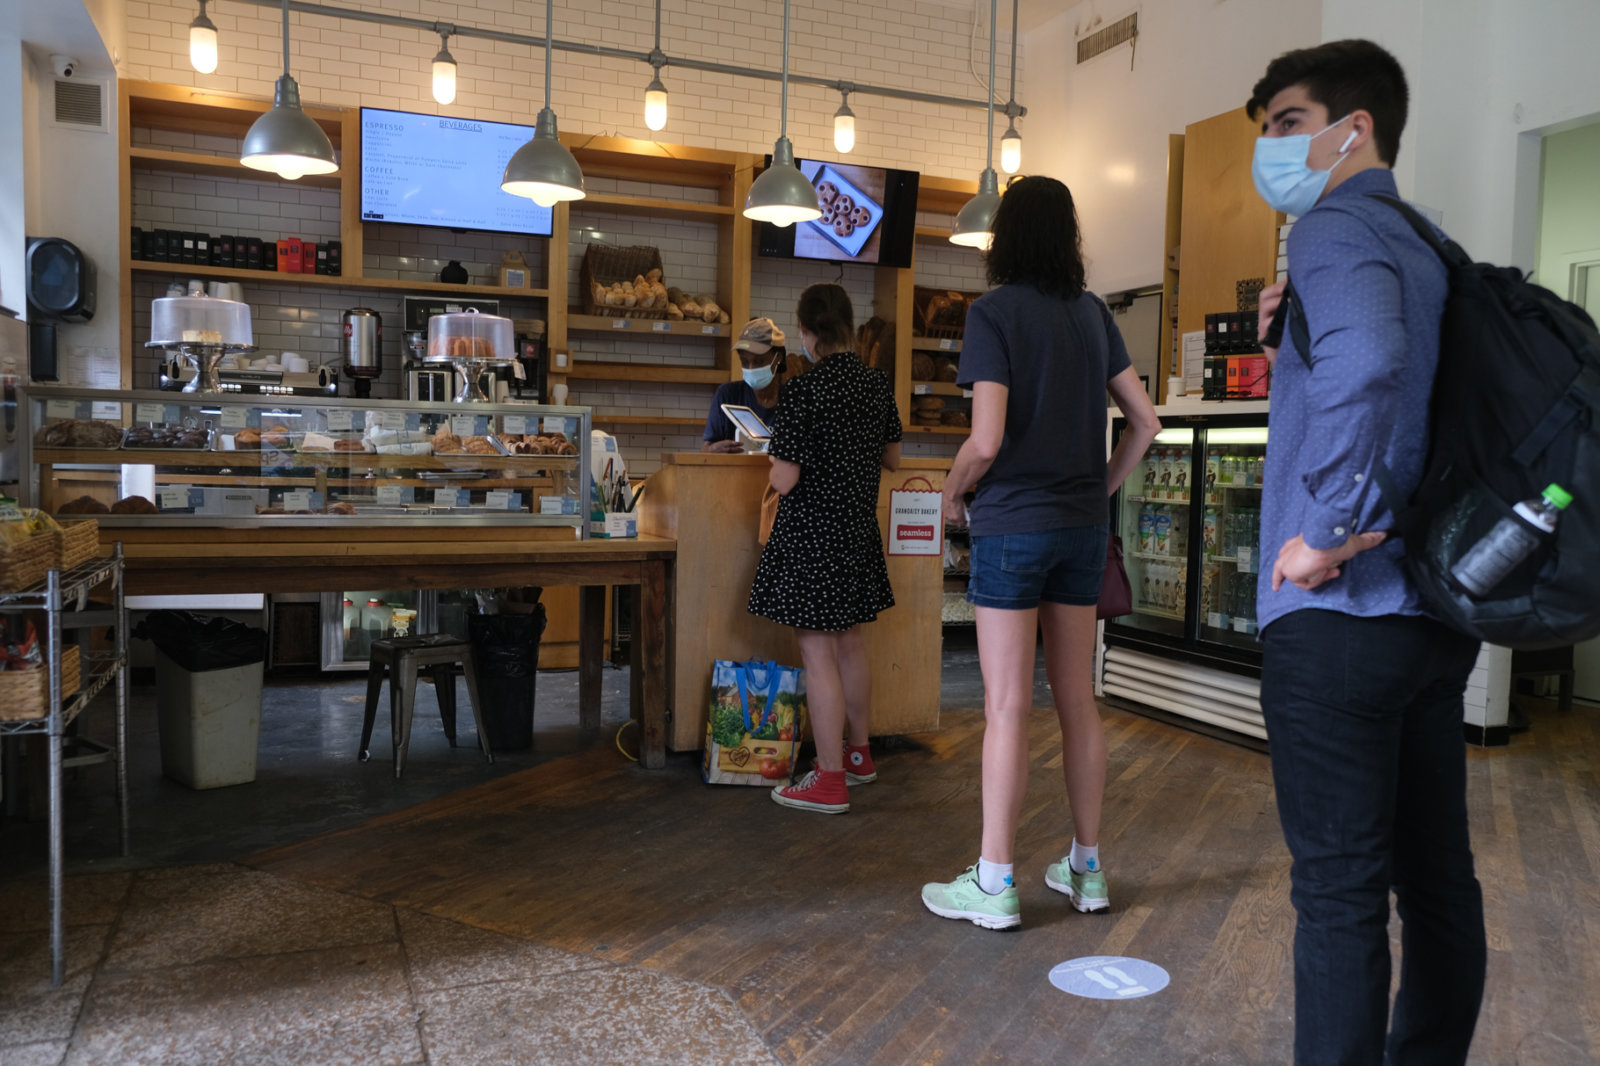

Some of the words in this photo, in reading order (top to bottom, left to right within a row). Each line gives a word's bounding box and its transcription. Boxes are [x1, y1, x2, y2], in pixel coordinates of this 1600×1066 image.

[365, 121, 404, 131] ESPRESSO
[439, 120, 482, 132] BEVERAGES
[365, 166, 393, 174] COFFEE
[365, 187, 389, 195] OTHER
[900, 529, 932, 537] seamless
